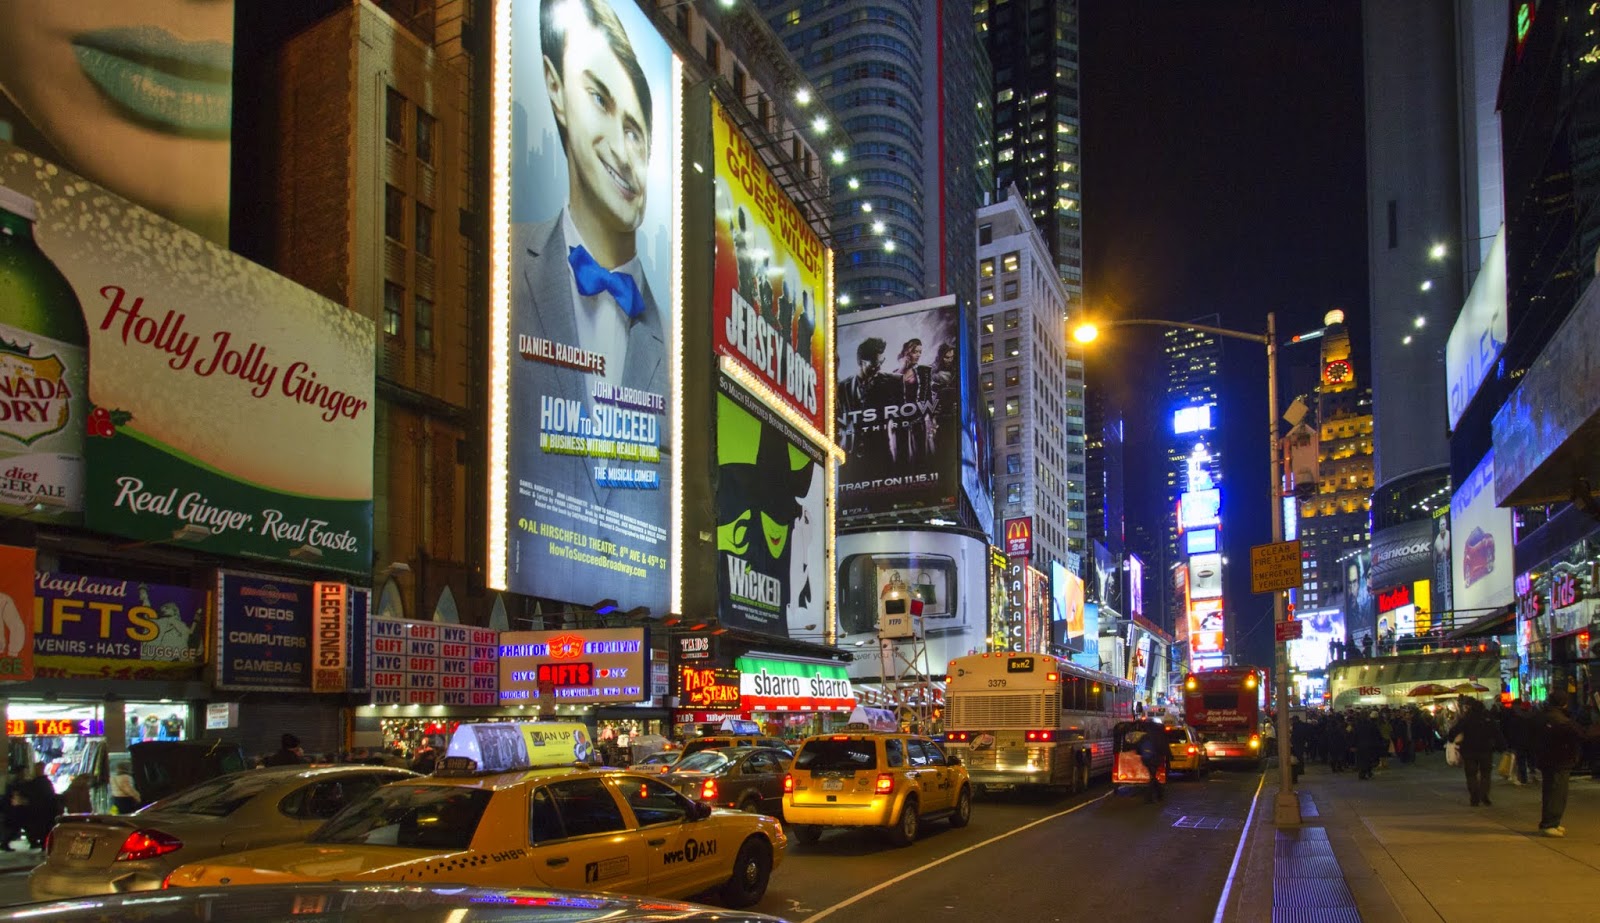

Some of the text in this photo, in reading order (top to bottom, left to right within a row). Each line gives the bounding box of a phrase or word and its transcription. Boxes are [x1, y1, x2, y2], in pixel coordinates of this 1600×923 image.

[726, 147, 775, 225] GOES
[766, 176, 819, 259] CROWD
[100, 285, 367, 422] Holly Jolly Ginger
[518, 333, 603, 371] DANIEL RADCLIFFE
[725, 288, 784, 386] JERSEY
[786, 342, 818, 416] BOYS
[592, 381, 664, 410] JOHN LARROQUETTE
[541, 395, 656, 443] HOW TO SUCCEED
[884, 399, 939, 419] ROW
[550, 435, 585, 450] BUSINESS
[587, 438, 615, 453] WITHOUT
[616, 441, 638, 456] REALLY
[5, 467, 40, 483] diet
[594, 466, 657, 483] THE MUSICAL COMEDY
[872, 479, 882, 488] IT
[884, 477, 902, 486] ON
[36, 484, 66, 498] ALE
[114, 476, 359, 553] Real Ginger. Real Taste.
[528, 520, 538, 535] AL
[540, 523, 587, 548] HIRSCHFELD
[629, 550, 641, 563] AVE
[659, 559, 667, 570] ST
[1261, 545, 1290, 557] CLEAR
[549, 542, 647, 578] HowToSucceedBroadway.com
[1254, 552, 1297, 567] FIRE LANE
[1254, 568, 1298, 579] EMERGENCY
[1258, 577, 1295, 589] VEHICLES
[1379, 585, 1409, 613] Kodak
[1551, 573, 1576, 610] Lids
[244, 605, 294, 621] VIDEOS
[1012, 565, 1021, 652] PALACE
[320, 584, 340, 668] ELECTRONICS
[377, 622, 496, 643] NYC GIFT NYC GIFT
[34, 638, 196, 660] VENIRS HATS LUGGAGE
[229, 631, 306, 648] COMPUTERS
[375, 639, 494, 659] GIFT NYC GIFT NYC
[681, 637, 709, 652] TADS
[233, 658, 303, 674] CAMERAS
[376, 656, 495, 674] NYC GIFT NYC GIFT
[539, 663, 590, 685] GIFTS
[375, 673, 494, 689] GIFT NYC GIFT NYC
[754, 668, 800, 697] sbarro
[810, 671, 849, 698] sbarro
[987, 679, 1007, 688] 3379
[1359, 686, 1381, 696] tkts
[376, 690, 495, 704] NYC GIFT NYC GIFT
[702, 685, 739, 705] STEAKS
[35, 719, 72, 735] TAG
[676, 713, 694, 722] TAD'S
[559, 731, 571, 740] UP
[663, 850, 684, 865] NYC
